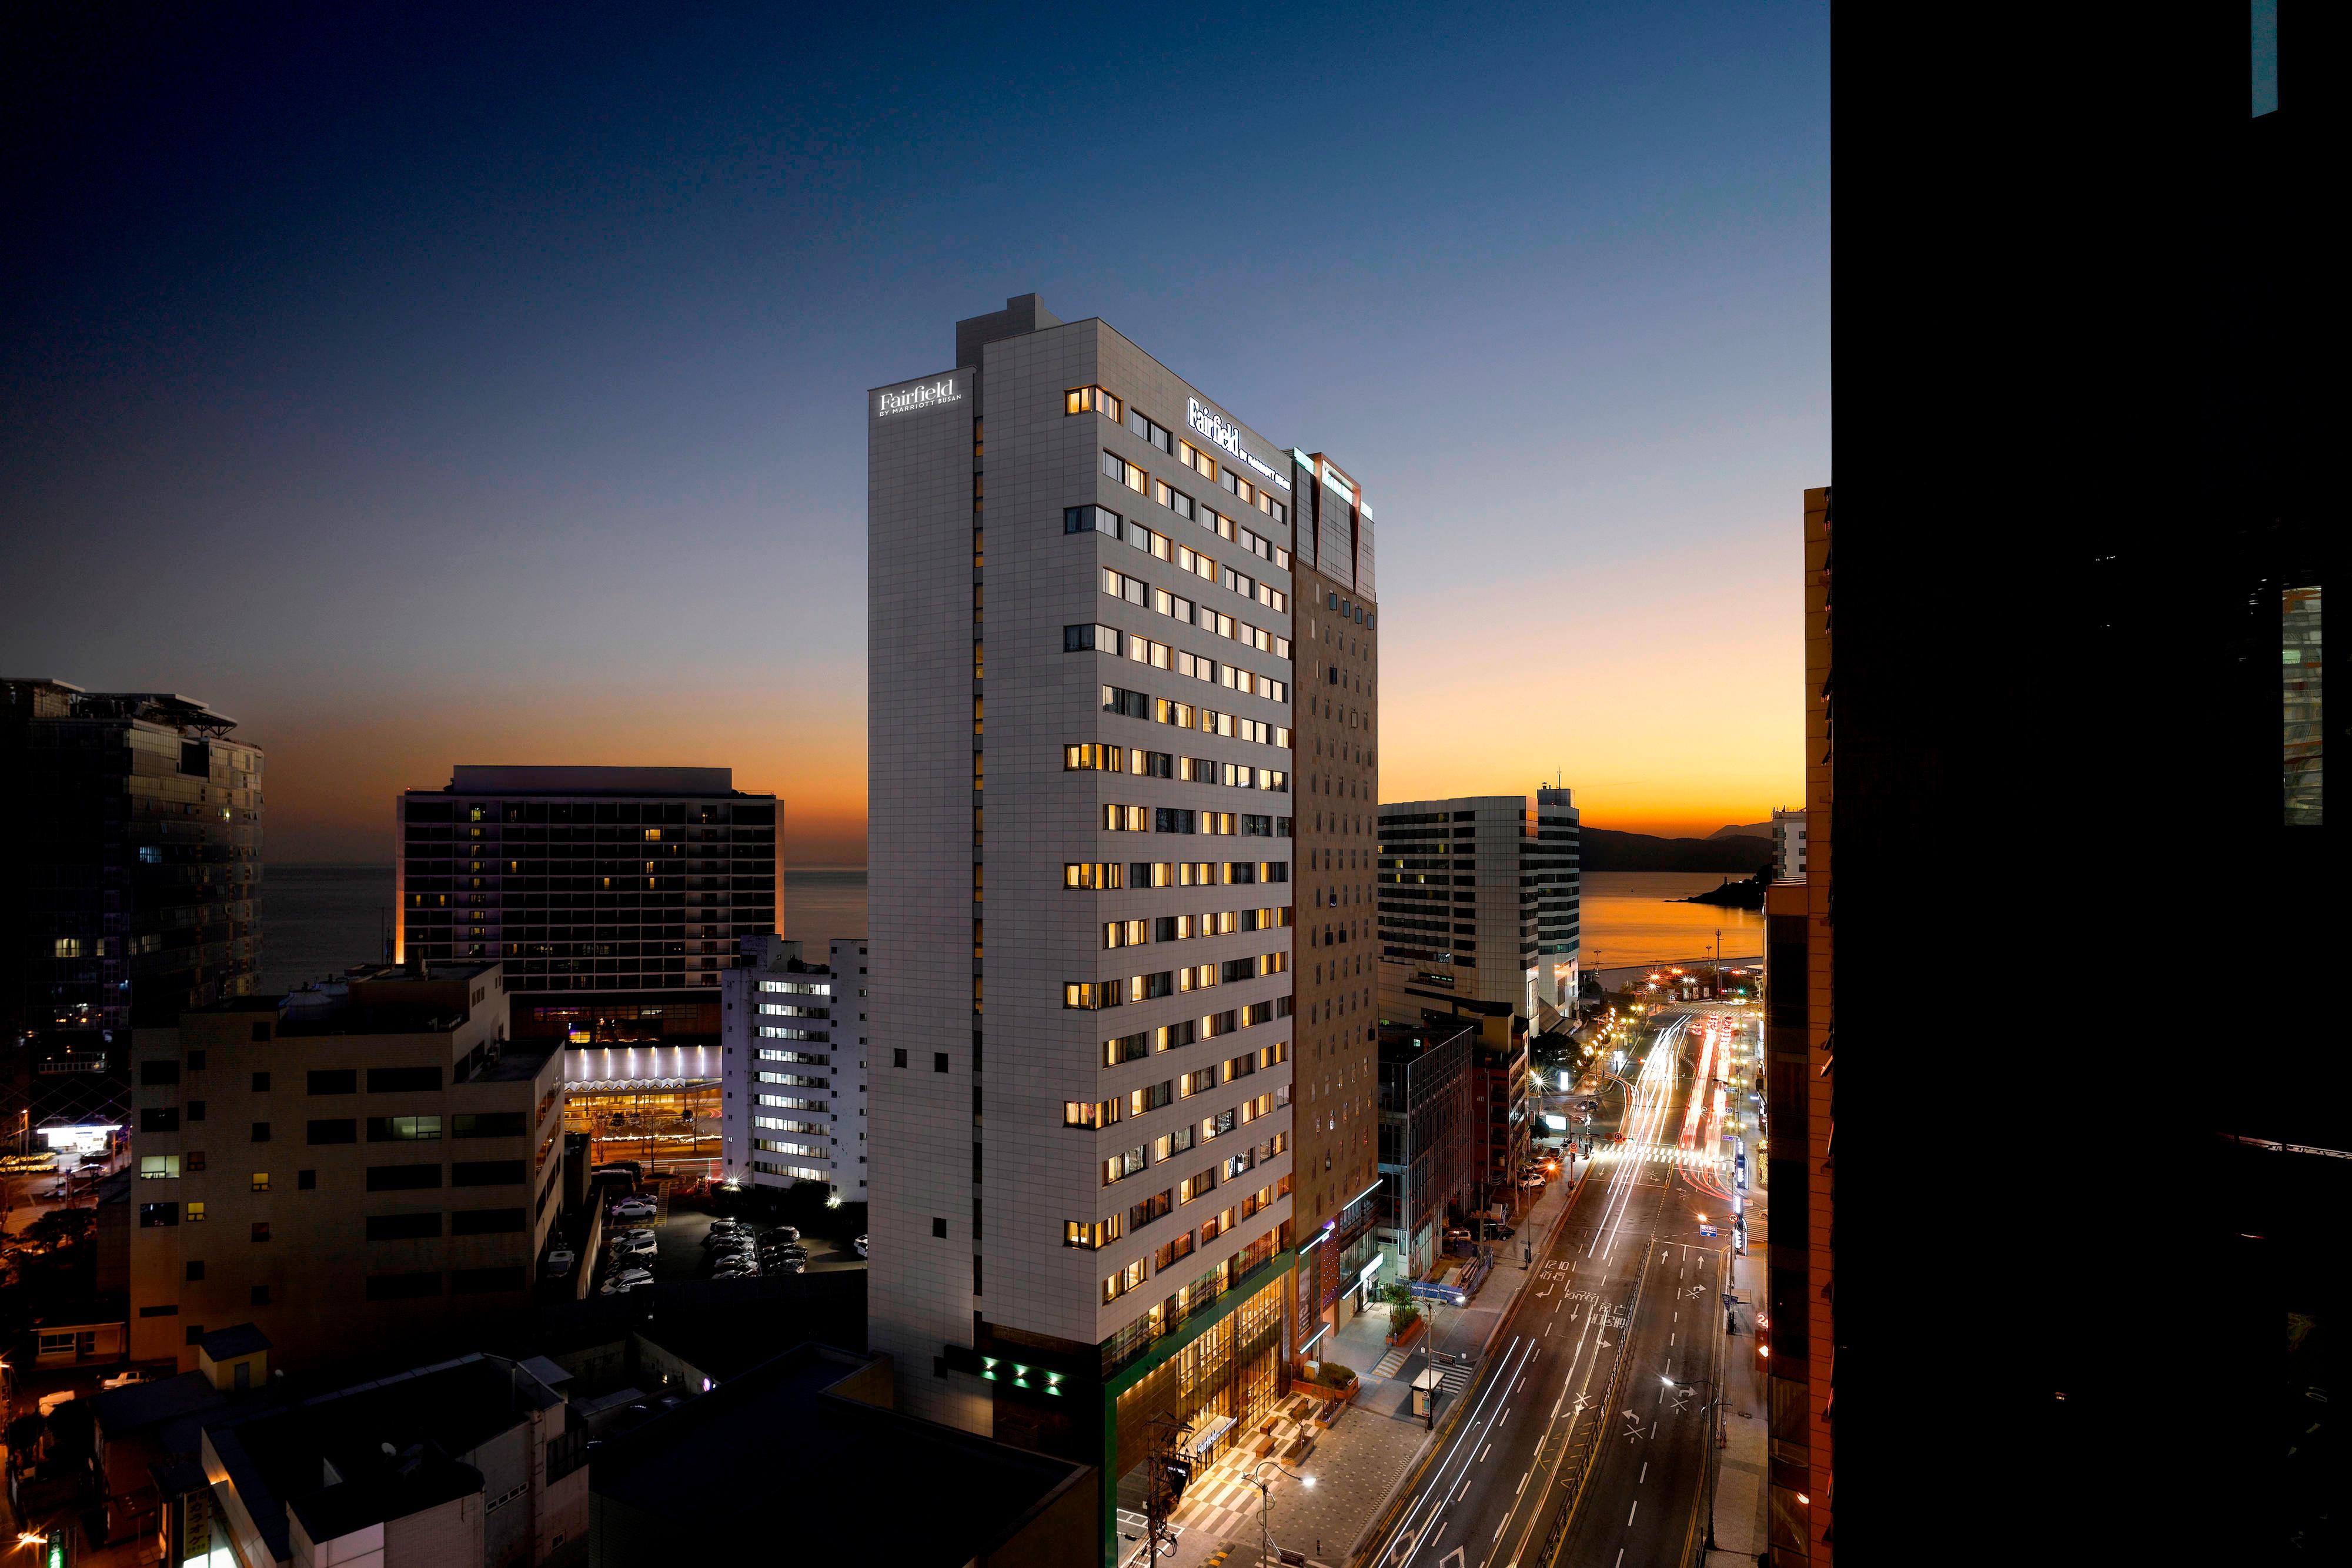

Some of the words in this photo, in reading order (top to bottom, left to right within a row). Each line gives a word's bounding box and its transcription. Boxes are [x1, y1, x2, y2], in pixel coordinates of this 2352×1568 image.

[880, 379, 953, 410] Fairfield
[893, 400, 935, 414] MARRIOTT
[938, 394, 961, 404] BUSAN
[1188, 396, 1240, 458] Fairfield
